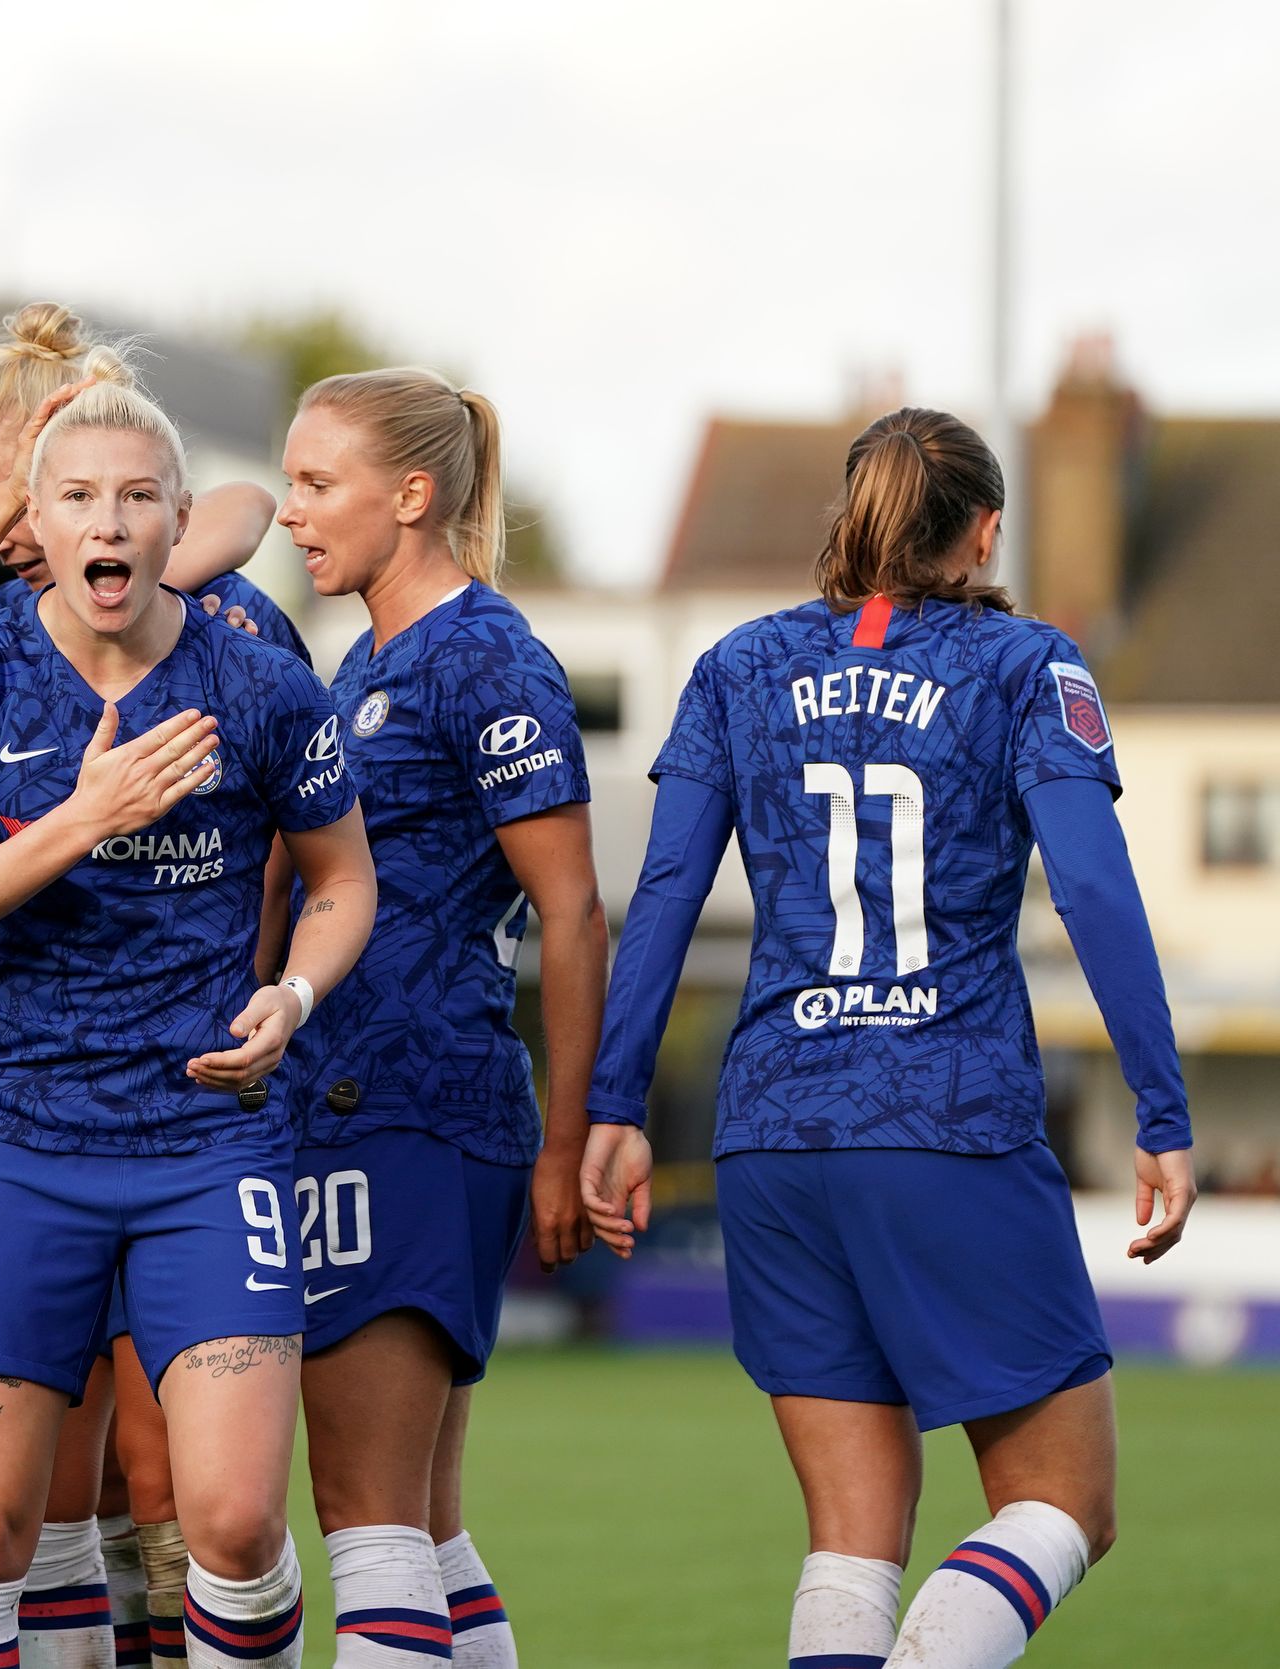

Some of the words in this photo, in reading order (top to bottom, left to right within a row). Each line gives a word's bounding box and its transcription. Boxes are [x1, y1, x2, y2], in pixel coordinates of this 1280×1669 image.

[791, 665, 946, 731] REITEN
[477, 748, 563, 791] HYUNDAI
[91, 827, 223, 861] KOHAMA
[803, 762, 930, 977] 11
[153, 857, 225, 886] TYRES
[842, 984, 938, 1016] PLAN
[237, 1177, 287, 1269] 9
[294, 1169, 372, 1272] 20
